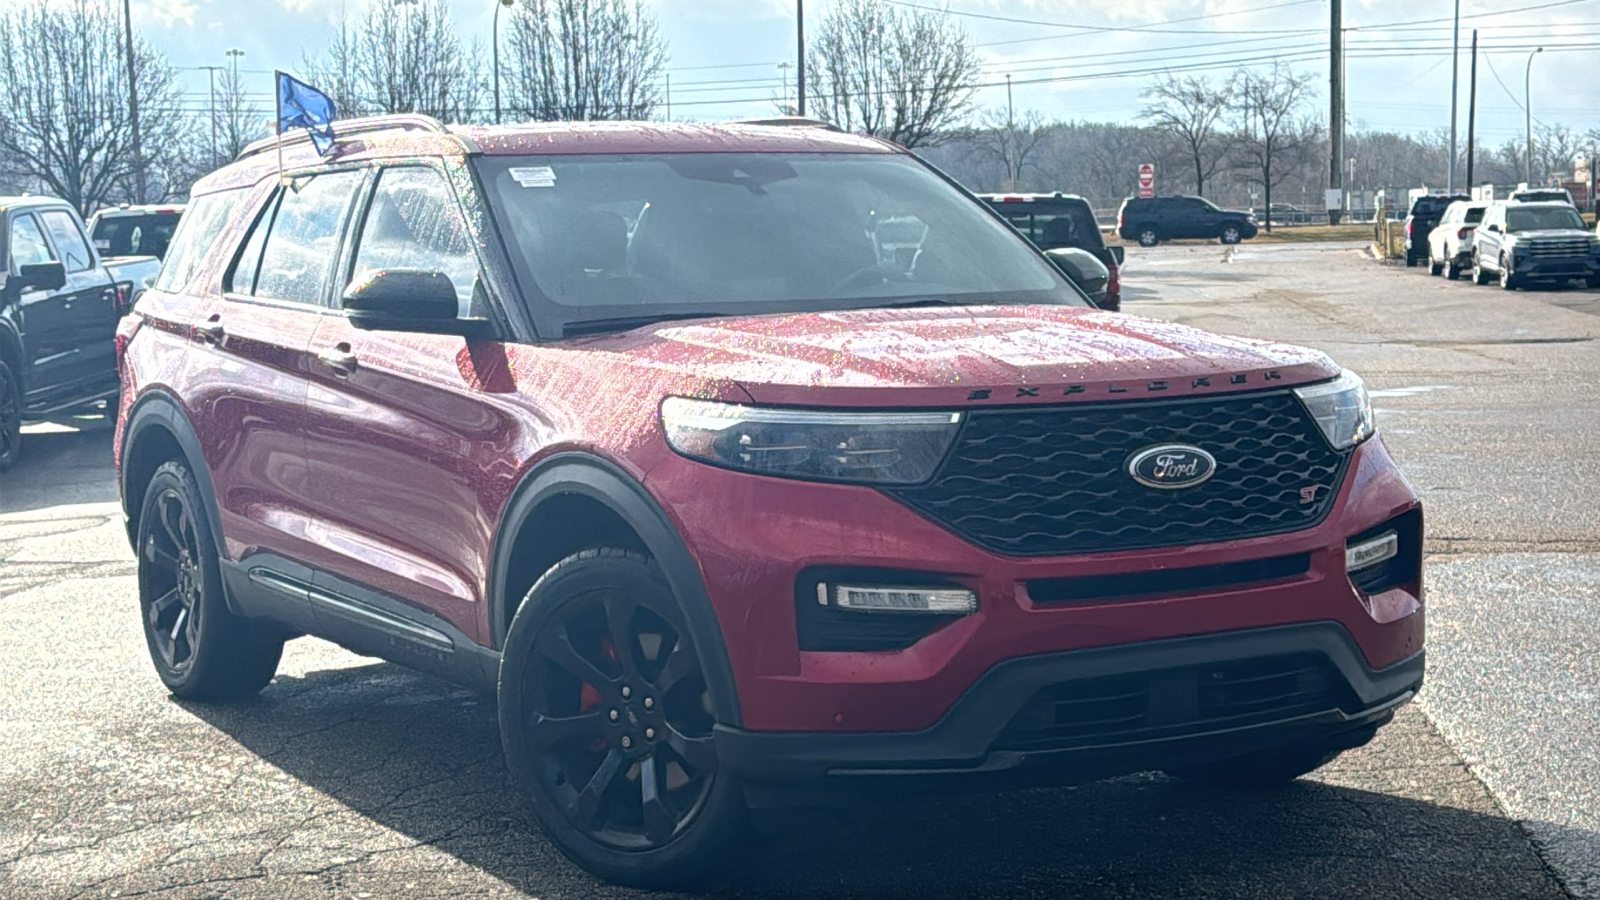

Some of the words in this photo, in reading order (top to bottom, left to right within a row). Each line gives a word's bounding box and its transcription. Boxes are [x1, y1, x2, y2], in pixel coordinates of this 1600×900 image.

[967, 370, 1282, 400] EXPLORER
[1153, 454, 1199, 478] Ford
[1299, 485, 1318, 504] ST
